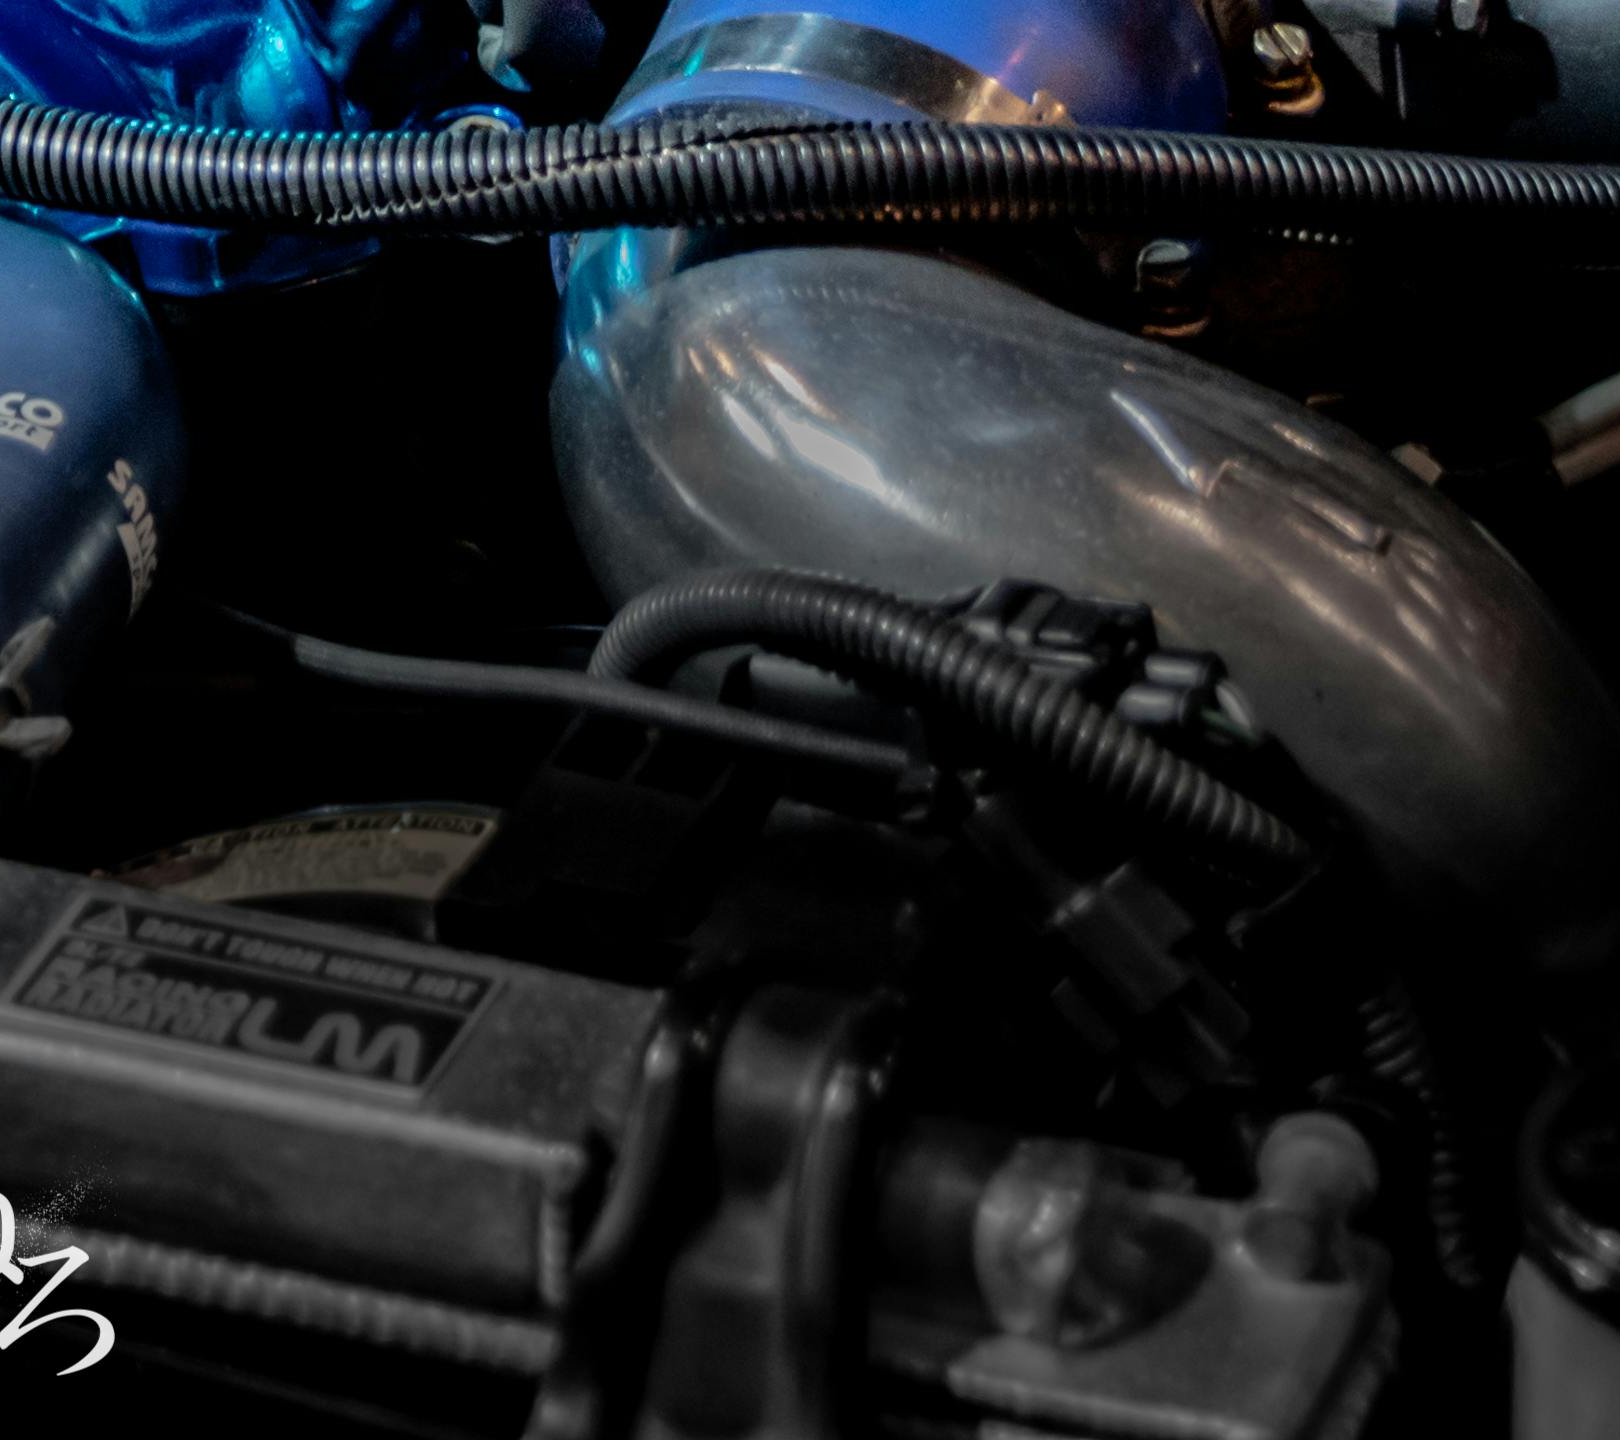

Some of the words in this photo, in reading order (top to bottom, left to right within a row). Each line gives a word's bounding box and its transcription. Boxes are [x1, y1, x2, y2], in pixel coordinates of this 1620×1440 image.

[42, 957, 251, 1015] RACING
[135, 917, 223, 951] DON'T
[226, 934, 322, 972] TOUCH
[325, 954, 411, 992] WHEN
[411, 973, 480, 1005] HOT
[24, 980, 235, 1045] RADIATOR
[237, 995, 424, 1084] LM
